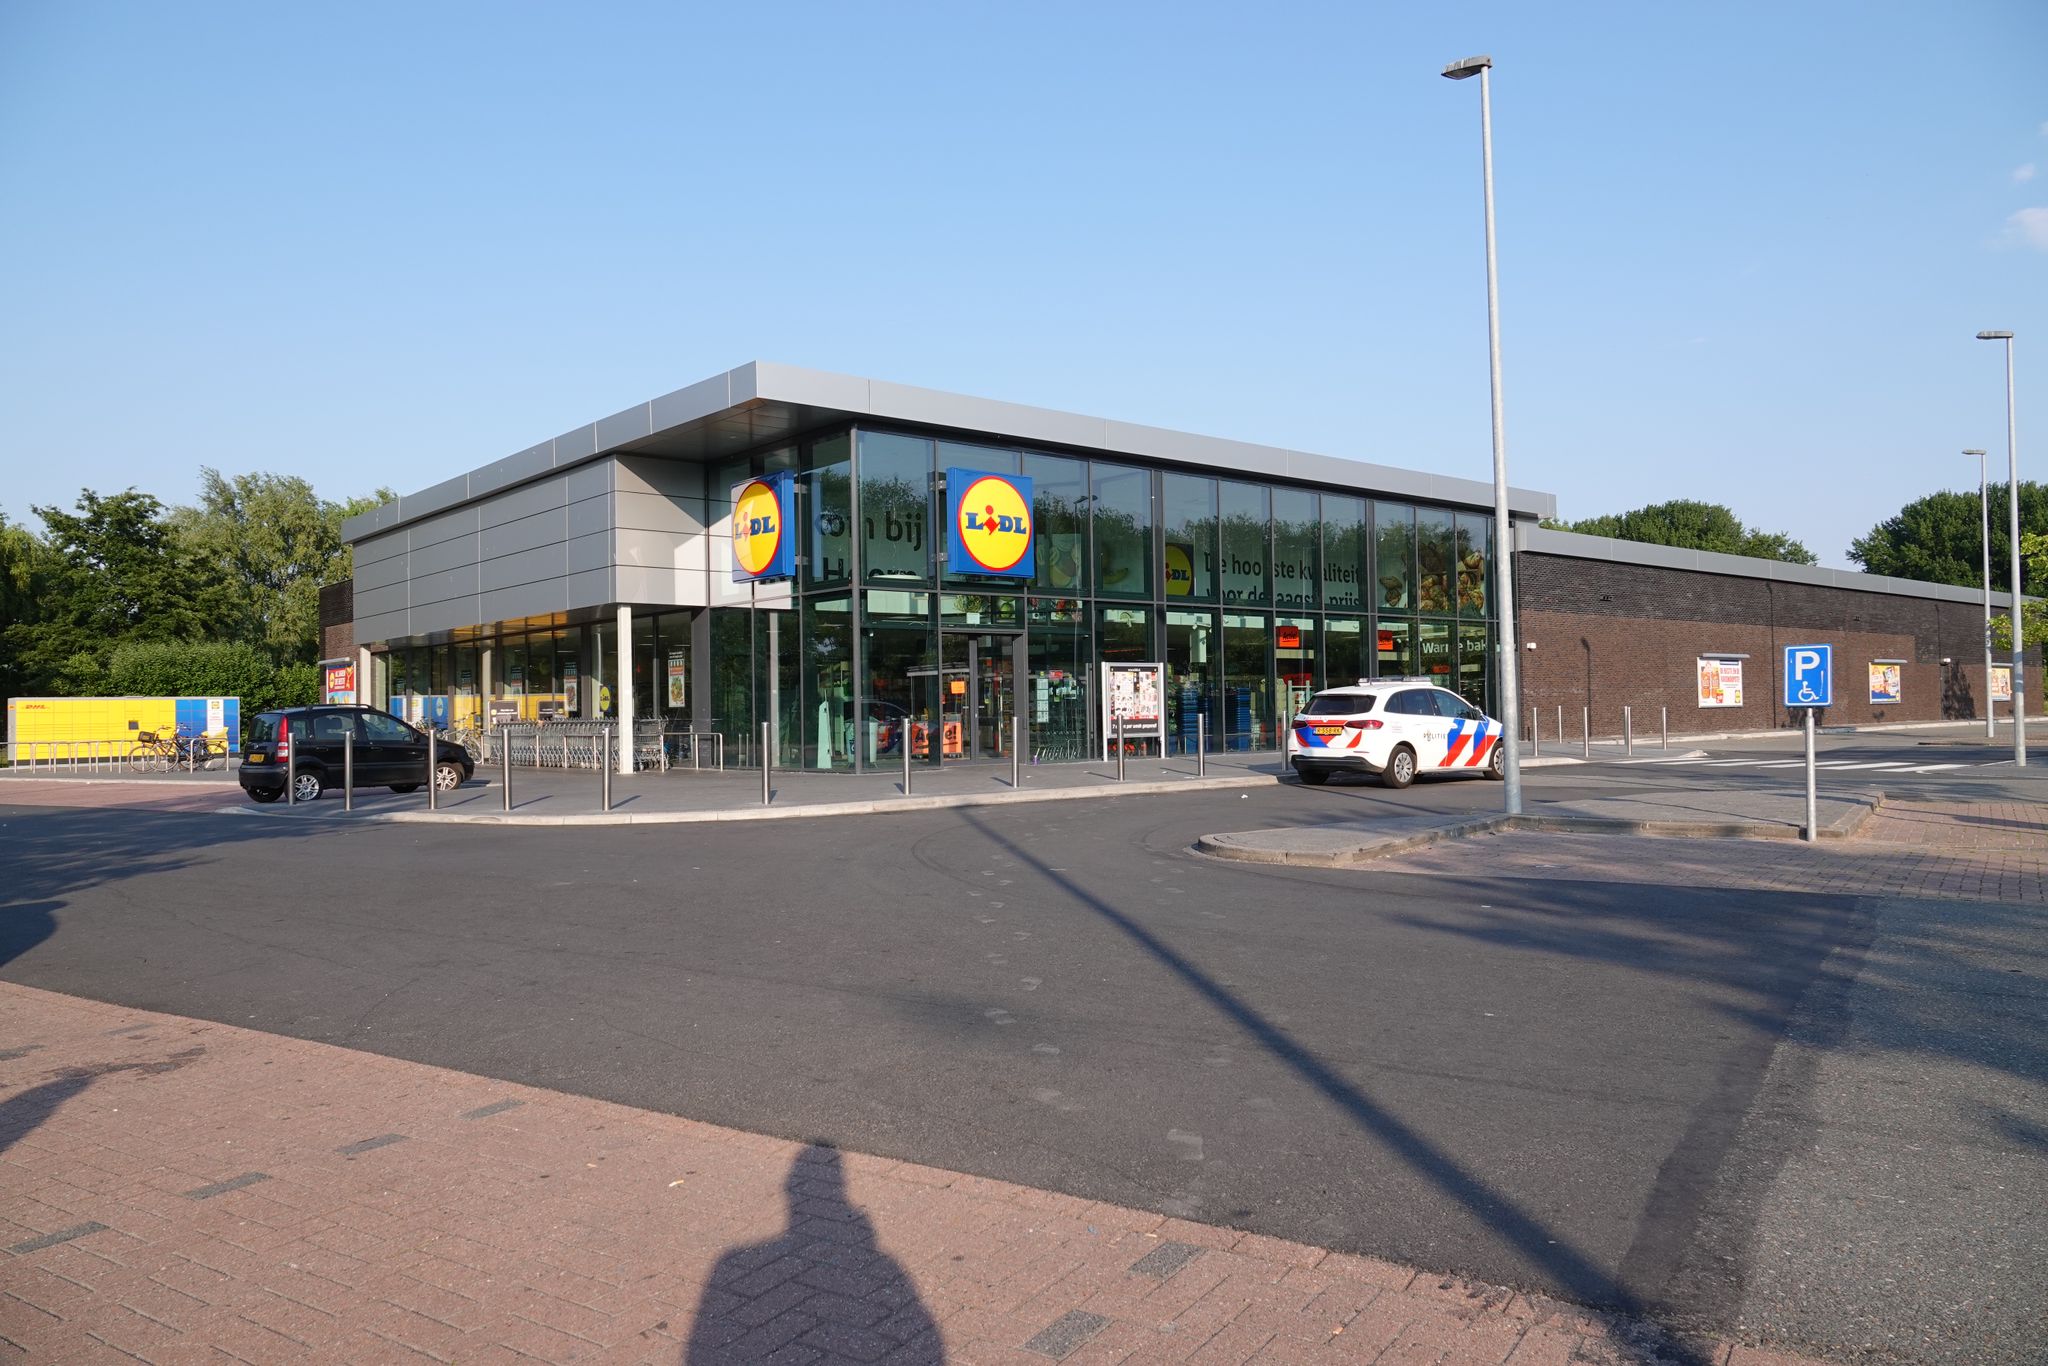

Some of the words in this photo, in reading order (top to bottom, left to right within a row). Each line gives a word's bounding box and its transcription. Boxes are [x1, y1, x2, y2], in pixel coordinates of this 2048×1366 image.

[886, 511, 922, 551] bij
[1232, 554, 1295, 579] hooste
[1299, 560, 1360, 584] kaliteit
[1795, 651, 1820, 680] P
[914, 725, 957, 743] Ae!
